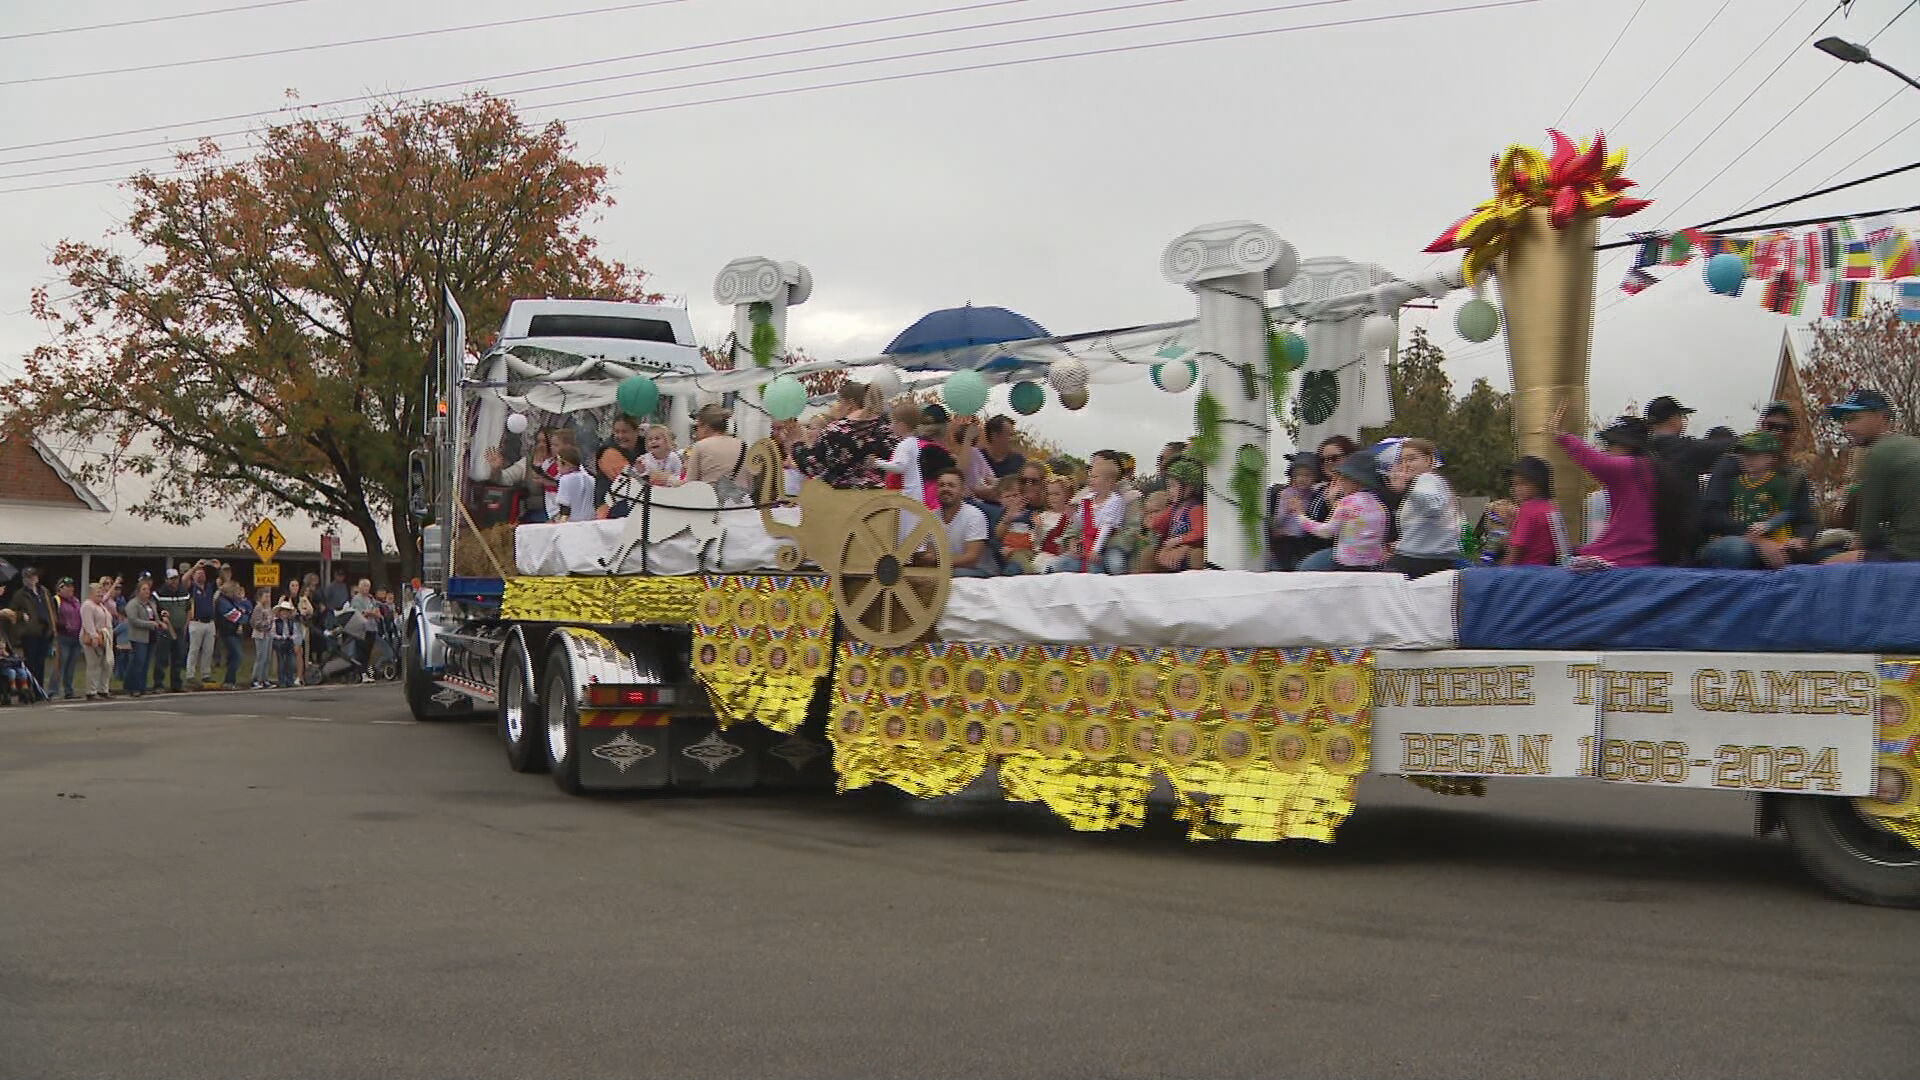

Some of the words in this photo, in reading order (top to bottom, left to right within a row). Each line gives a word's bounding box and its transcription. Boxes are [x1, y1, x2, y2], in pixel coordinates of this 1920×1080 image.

[1370, 665, 1535, 707] WHERE
[1567, 664, 1674, 713] THE
[1689, 668, 1877, 715] GAMES
[1400, 732, 1552, 775] BEGAN
[1576, 735, 1842, 791] 1896-2024
